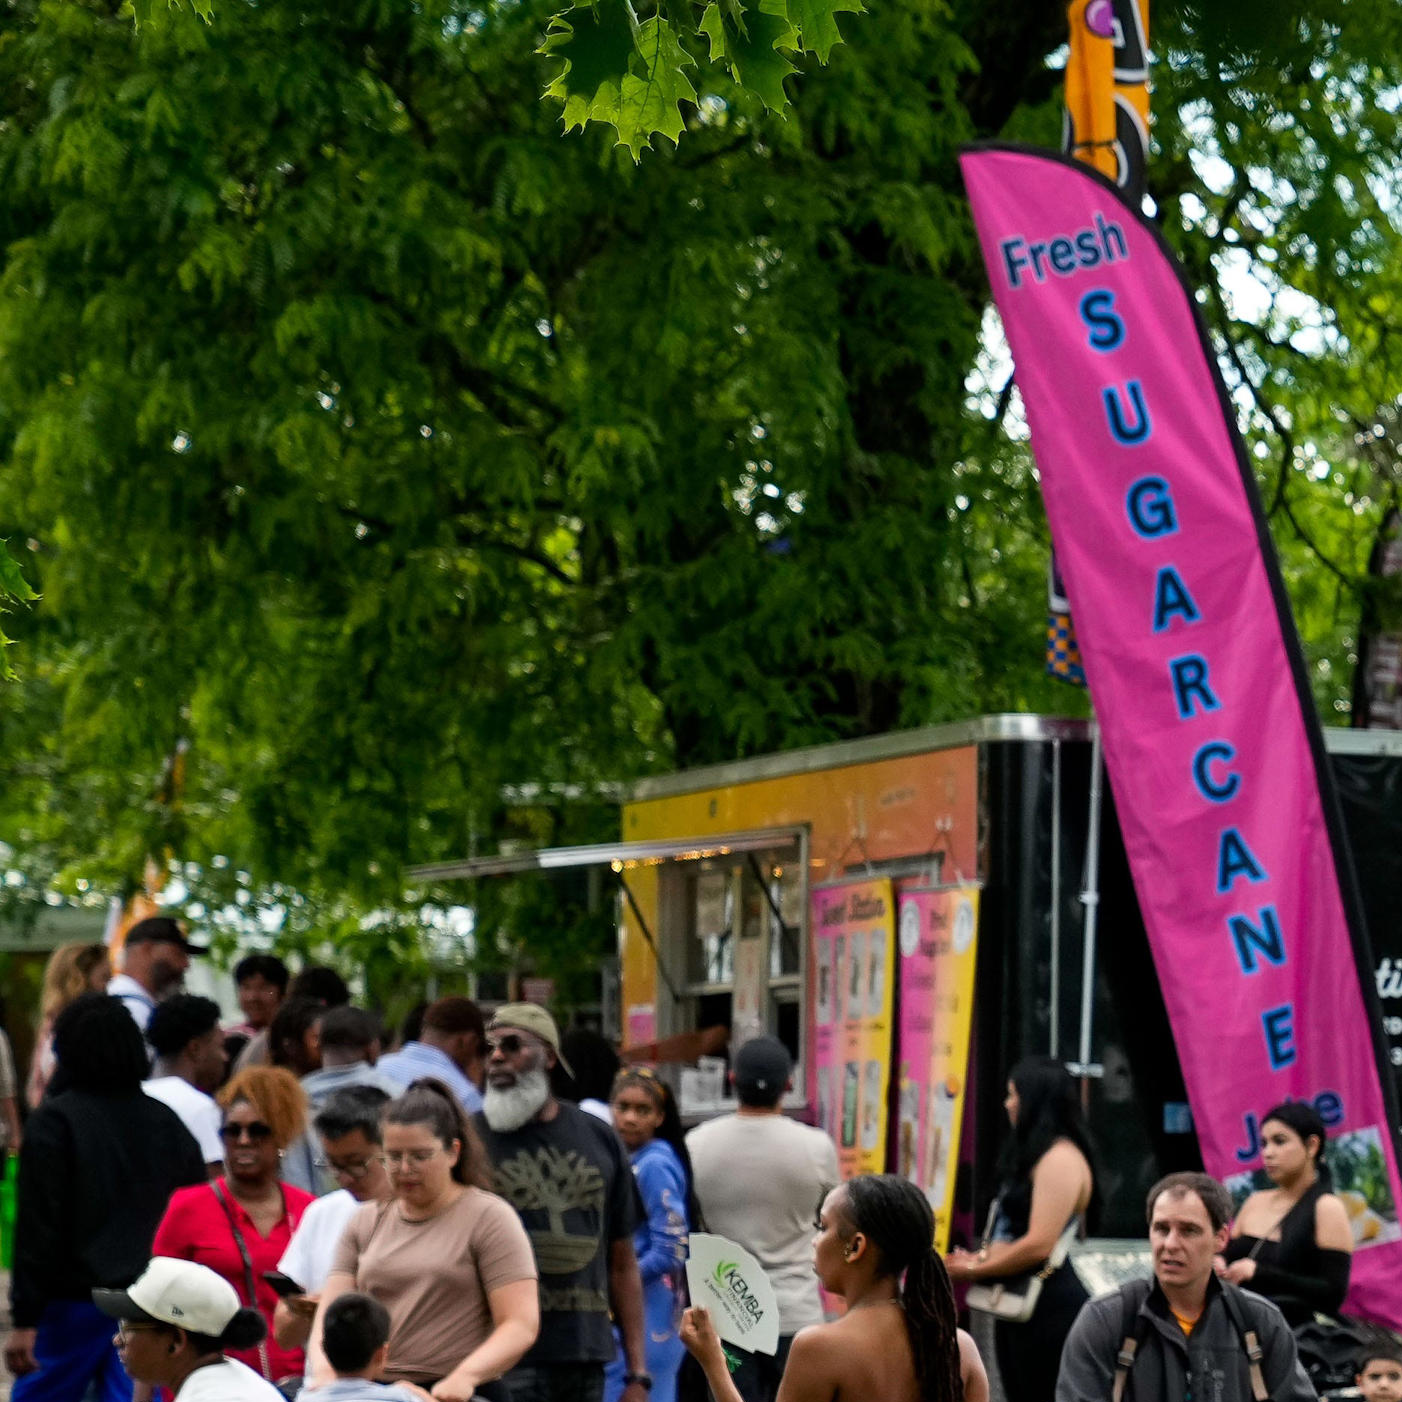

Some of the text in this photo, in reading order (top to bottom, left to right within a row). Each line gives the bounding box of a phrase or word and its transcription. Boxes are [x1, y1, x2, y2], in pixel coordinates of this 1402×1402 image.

[1000, 212, 1128, 289] Fresh
[1079, 288, 1296, 1070] SUGARCANE
[725, 1269, 764, 1324] KEMBA
